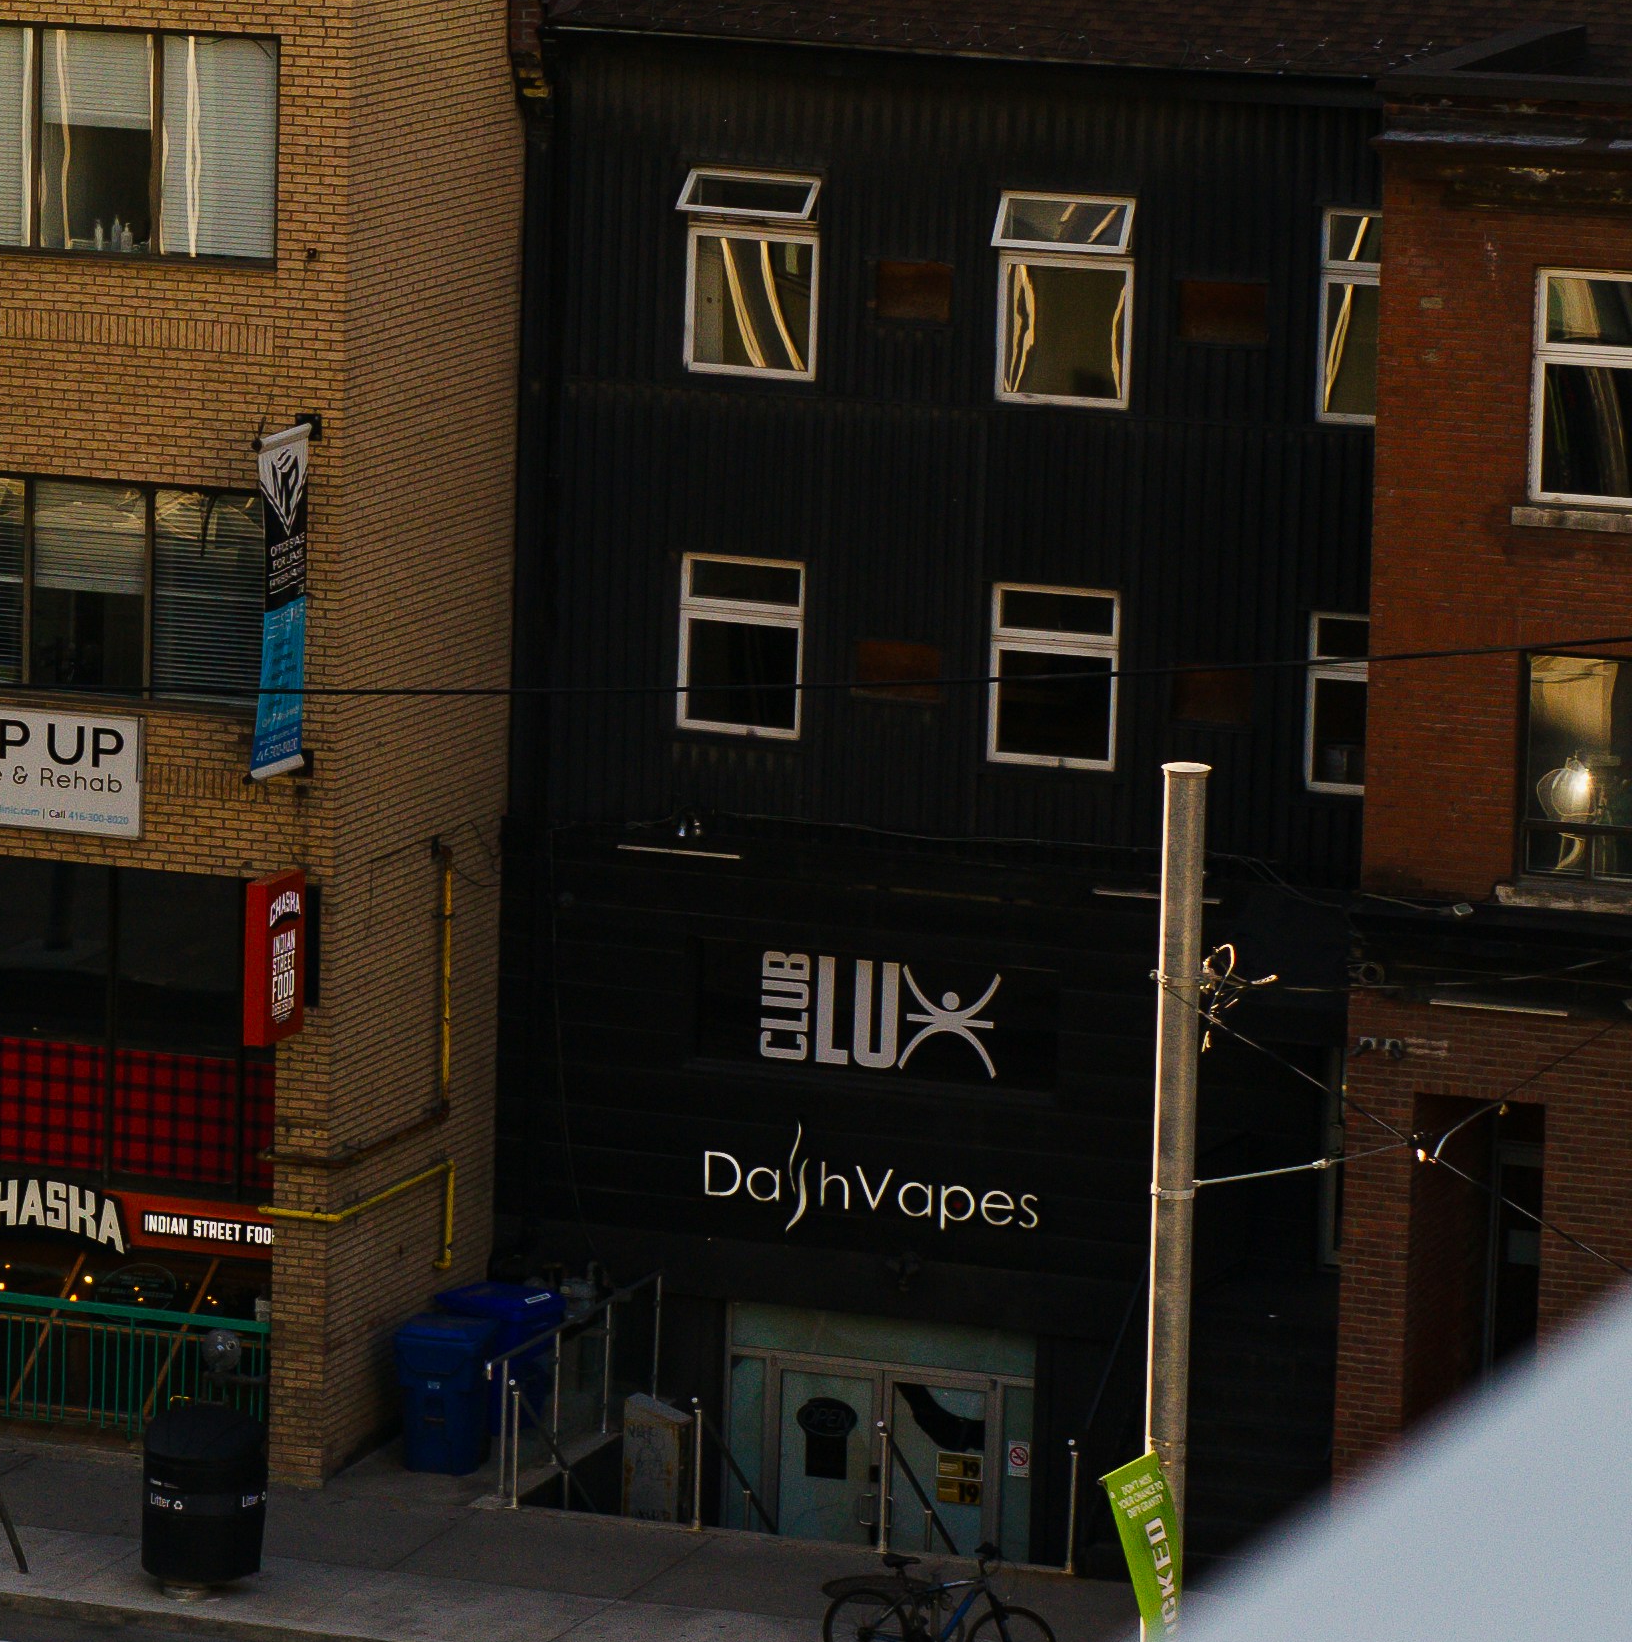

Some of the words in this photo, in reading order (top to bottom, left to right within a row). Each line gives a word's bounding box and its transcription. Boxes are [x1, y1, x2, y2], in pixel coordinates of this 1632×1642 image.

[47, 723, 125, 768] UP
[12, 766, 29, 785] &
[40, 767, 123, 794] Rehab
[48, 809, 66, 819] Call
[270, 890, 301, 928] CHASKA
[272, 928, 296, 958] INDIAN
[272, 950, 296, 976] STREET
[272, 969, 296, 1004] FOOD
[759, 950, 811, 1061] CLUB
[704, 1117, 1039, 1234] DashVapes
[143, 1212, 189, 1237] INDIAN
[192, 1218, 241, 1243] STREET
[962, 1459, 980, 1478] 19
[150, 1492, 171, 1508] Litter
[959, 1482, 980, 1503] 19
